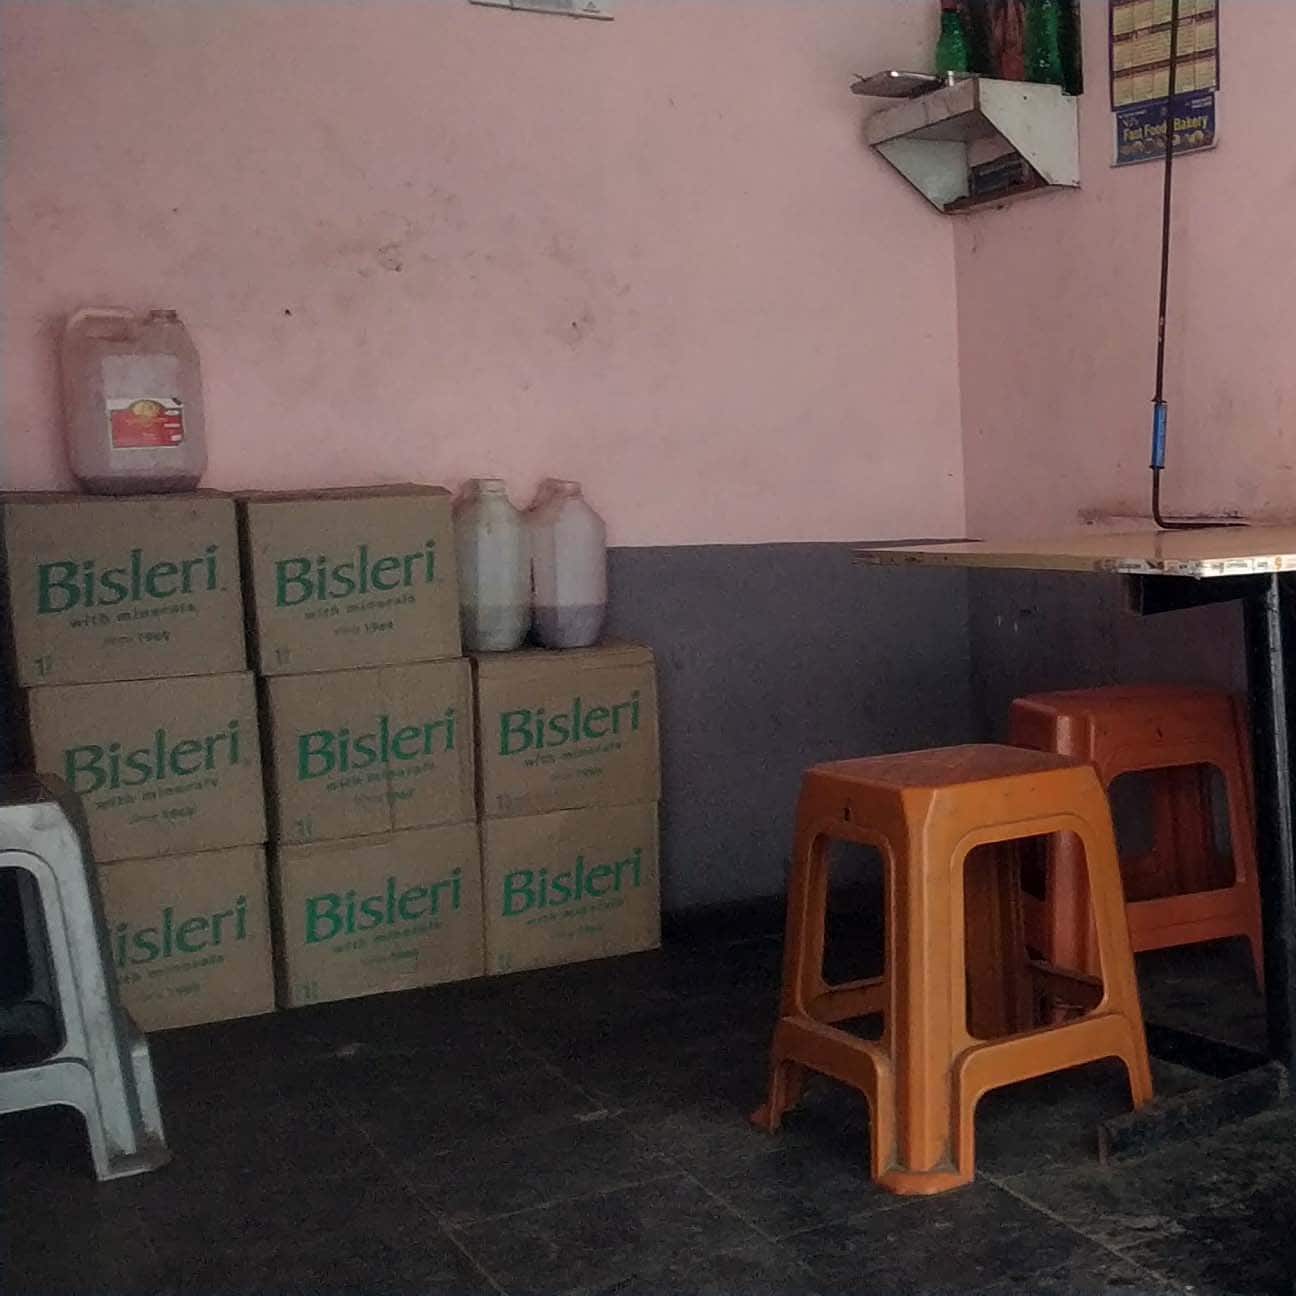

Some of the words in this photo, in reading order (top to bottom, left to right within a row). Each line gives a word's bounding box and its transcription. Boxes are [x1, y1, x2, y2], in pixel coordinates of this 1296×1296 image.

[1173, 115, 1208, 131] Bakery
[37, 544, 219, 615] Bisleri
[274, 538, 436, 608] Bisleri
[63, 718, 240, 796] Bisleri
[295, 706, 456, 782] Bisleri
[497, 688, 641, 757] Bisleri
[303, 865, 462, 945] Bisleri
[501, 847, 643, 917] Bisleri
[113, 894, 248, 968] isleri
